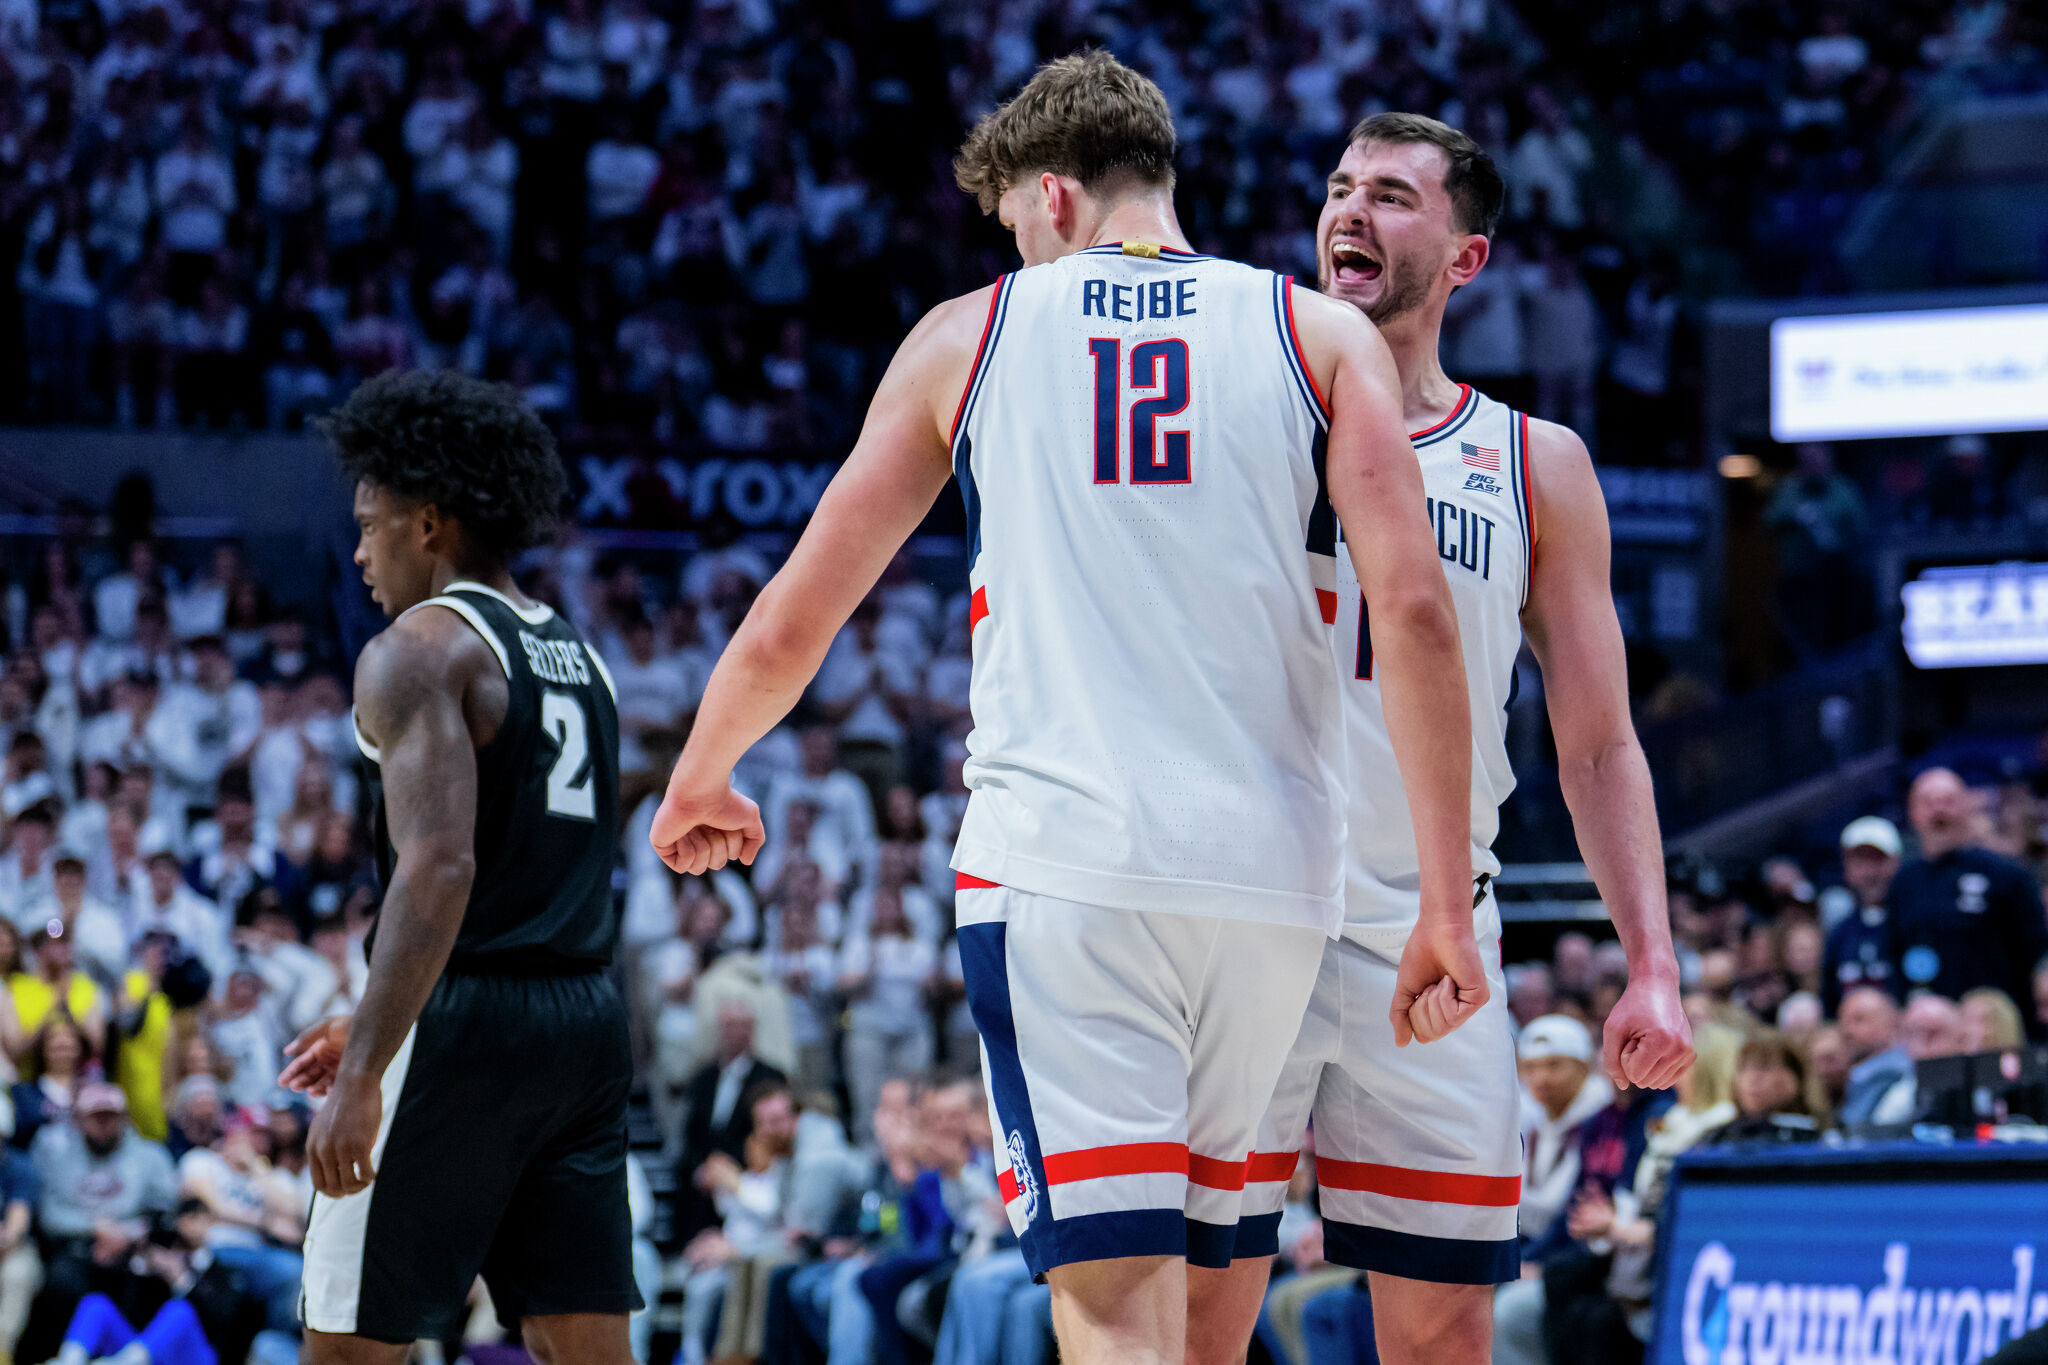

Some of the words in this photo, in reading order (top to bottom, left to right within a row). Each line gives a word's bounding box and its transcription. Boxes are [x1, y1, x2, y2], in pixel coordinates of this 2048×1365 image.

[1083, 278, 1197, 322] REIBE
[1088, 337, 1192, 484] 12
[578, 456, 838, 526] xrox
[1464, 480, 1503, 495] EAST
[1468, 472, 1497, 485] BIG
[518, 629, 592, 686] SELLERS
[541, 687, 597, 822] 2
